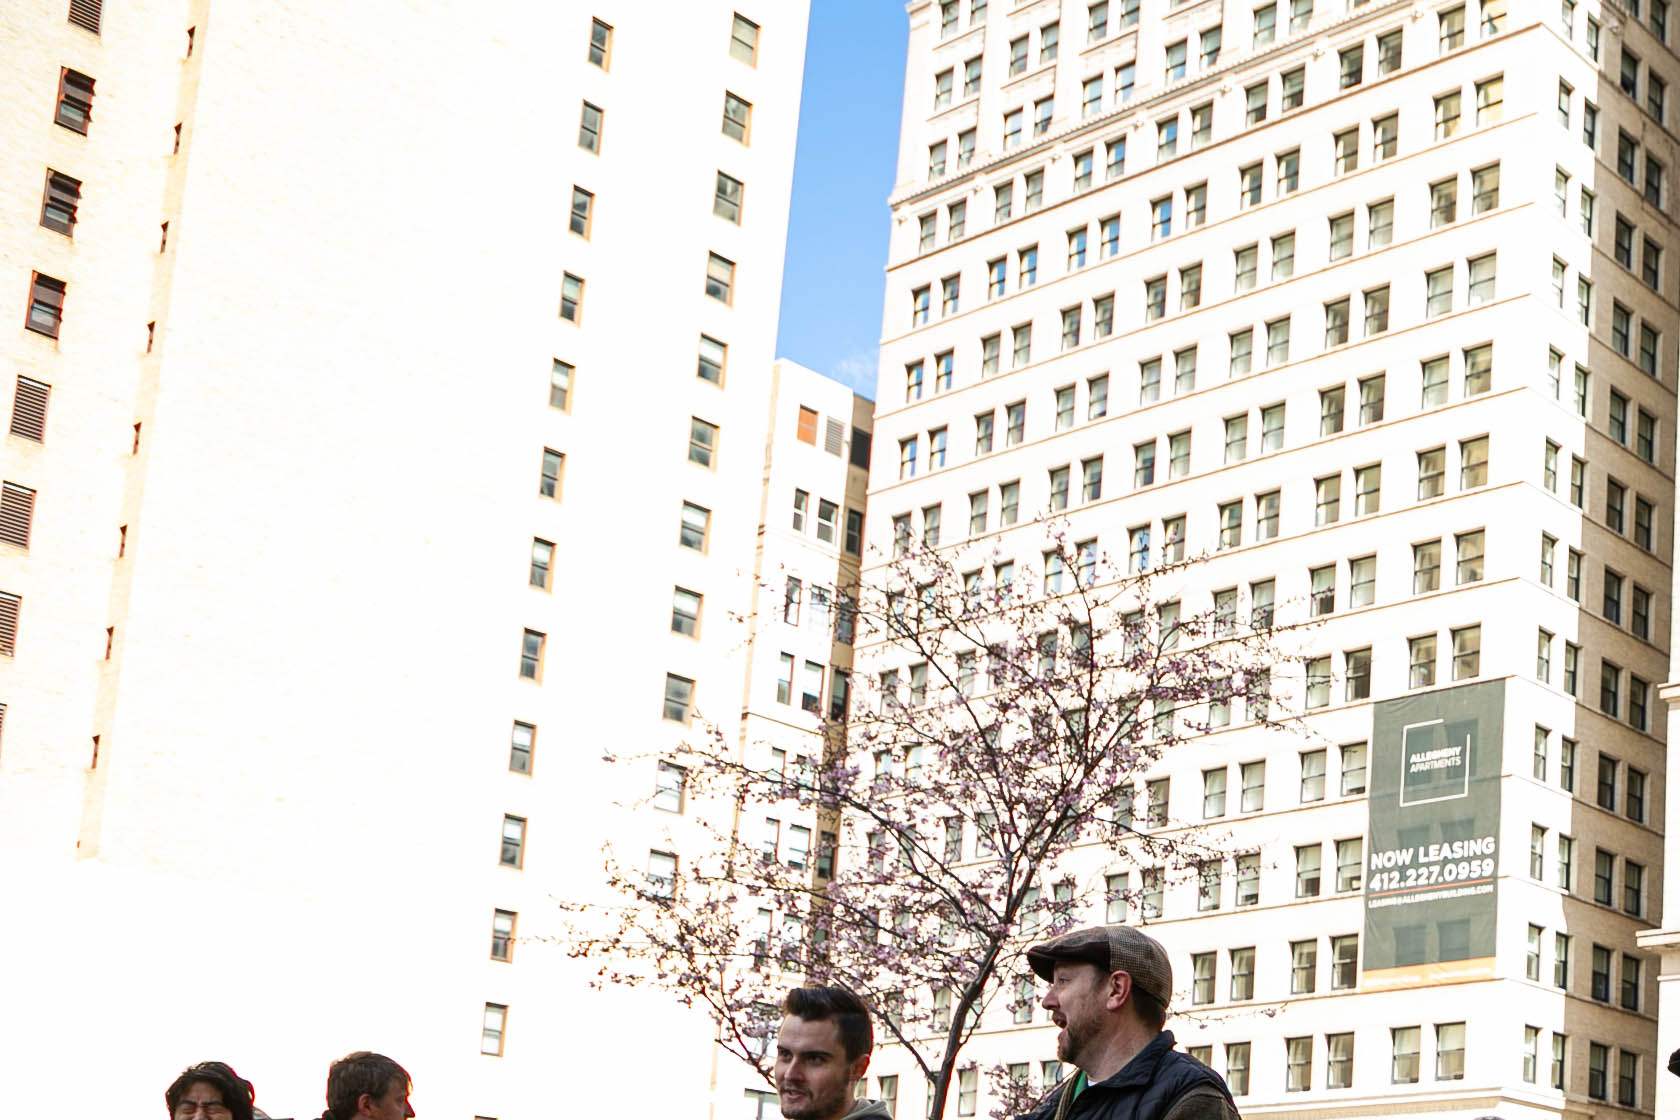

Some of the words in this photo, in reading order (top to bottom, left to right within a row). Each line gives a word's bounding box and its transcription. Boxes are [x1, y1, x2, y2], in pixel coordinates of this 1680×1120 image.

[1409, 746, 1462, 763] ALLEGHENY
[1409, 756, 1462, 773] APARTMENTS
[1370, 847, 1414, 871] NOW
[1418, 836, 1496, 863] LEASING
[1368, 858, 1495, 892] 412.227.0959
